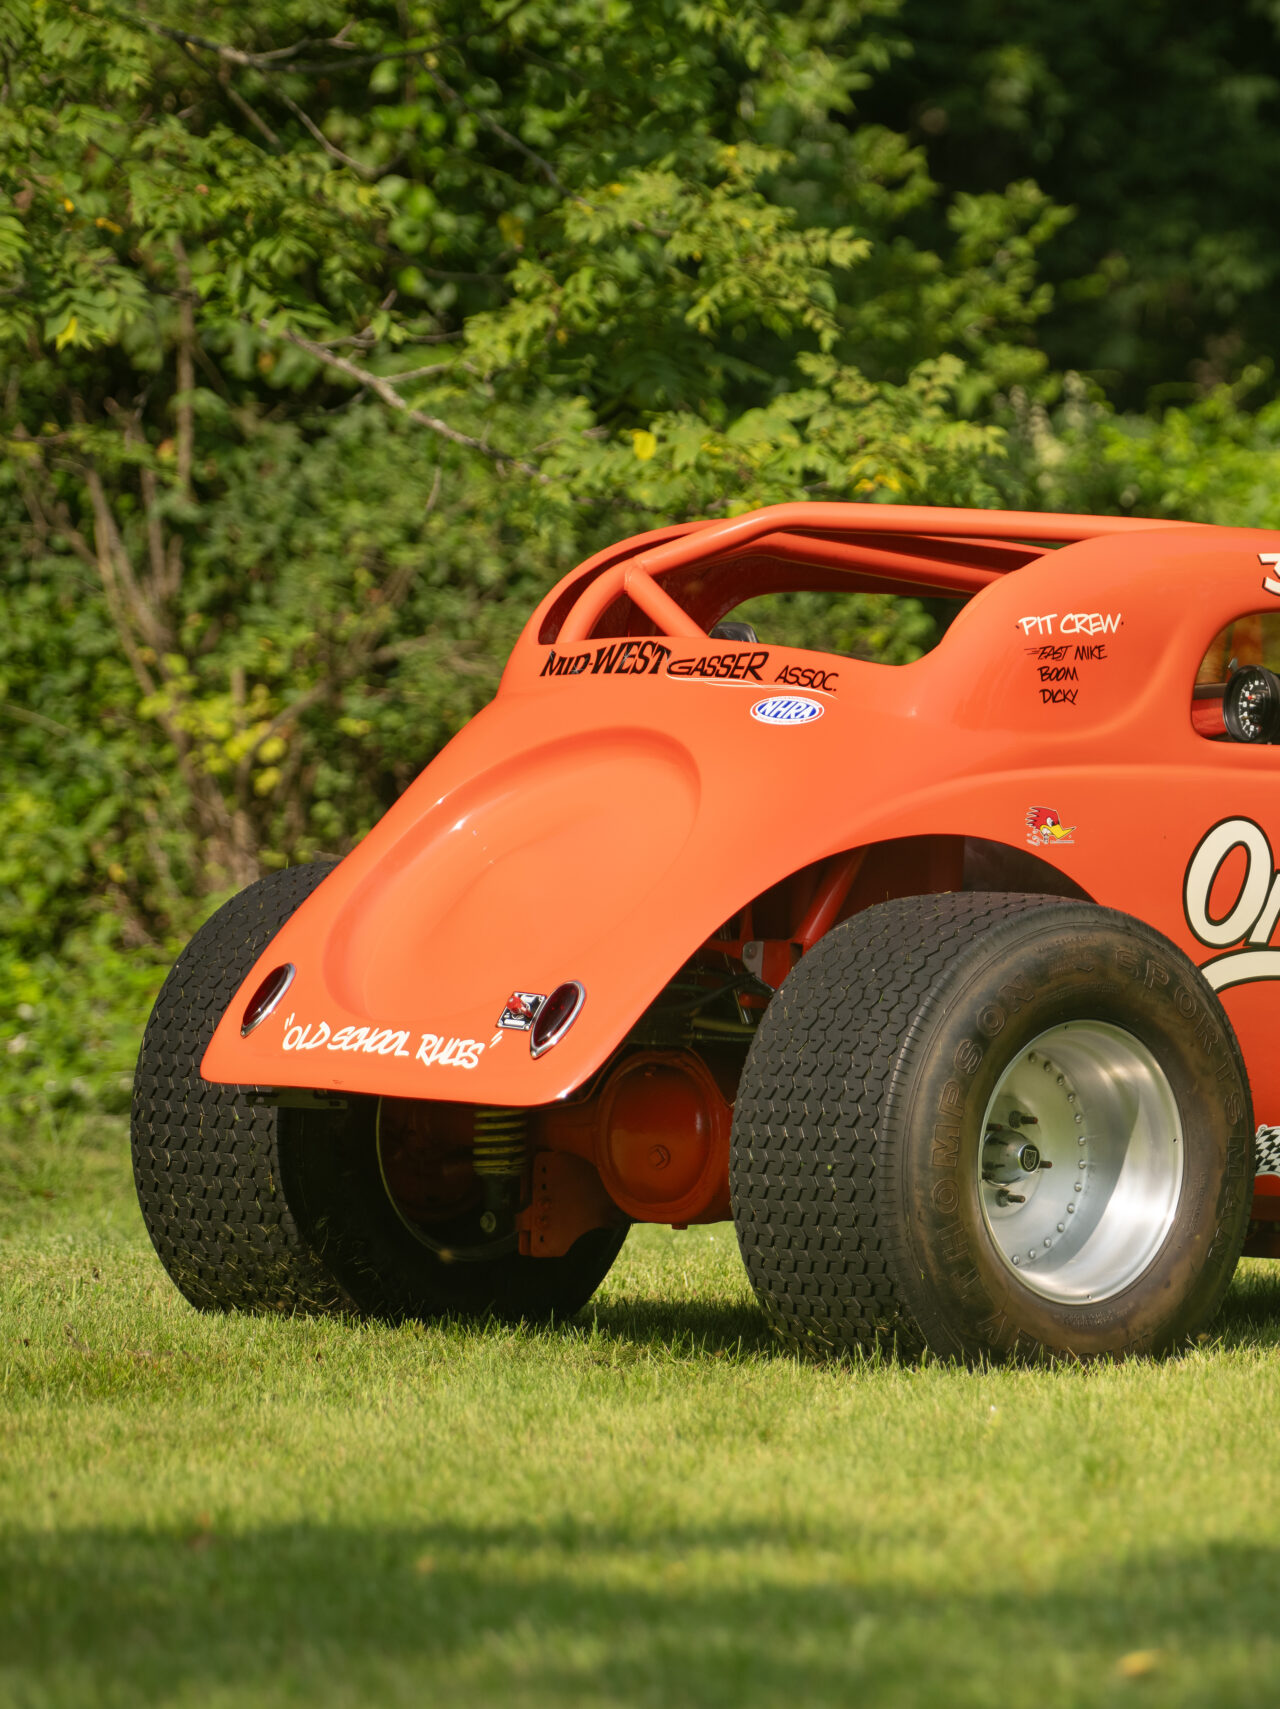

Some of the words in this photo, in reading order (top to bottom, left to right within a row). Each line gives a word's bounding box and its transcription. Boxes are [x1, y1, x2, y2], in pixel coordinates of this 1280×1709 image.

[1018, 614, 1058, 636] PIT
[1060, 613, 1121, 636] CREW
[1037, 645, 1073, 661] FAST
[1074, 644, 1108, 661] MIKE
[540, 641, 672, 677] MID-WEST
[667, 651, 769, 681] GASSER
[774, 665, 839, 692] ASSOC.
[1037, 666, 1079, 682] BOOM
[1039, 688, 1078, 705] DICKY
[758, 700, 818, 719] NHRA
[326, 1026, 410, 1057] SCHOOL
